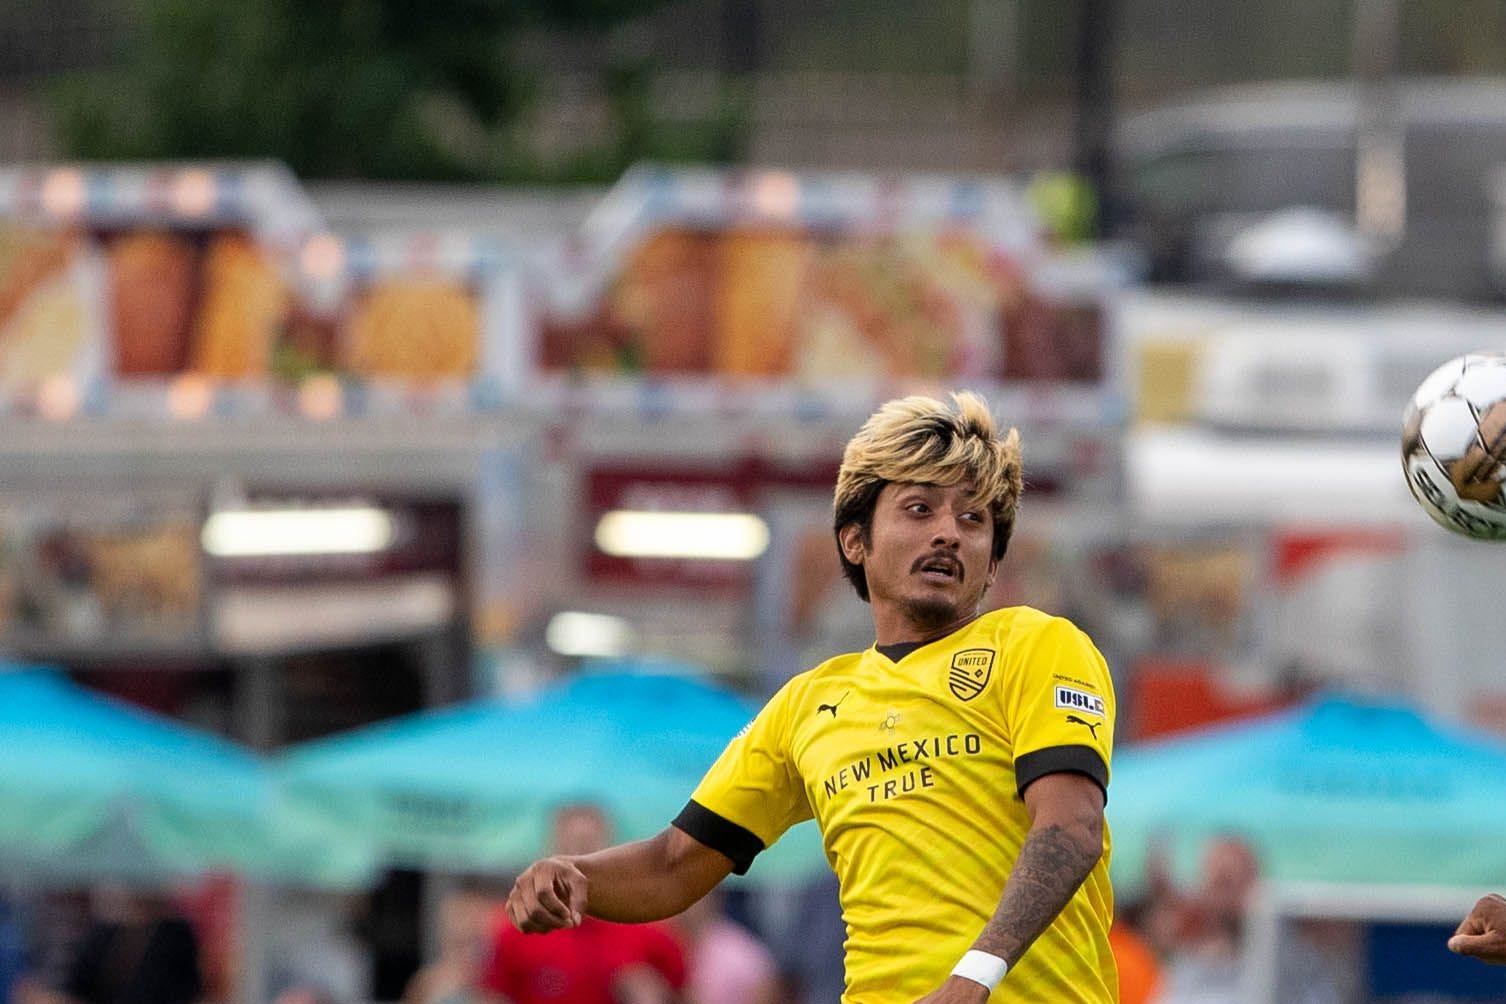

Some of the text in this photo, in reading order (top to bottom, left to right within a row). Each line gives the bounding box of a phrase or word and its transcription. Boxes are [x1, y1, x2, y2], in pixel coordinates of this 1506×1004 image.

[957, 656, 988, 667] UNITED
[824, 734, 981, 800] NEW MEXICO
[867, 767, 934, 802] TRUE
